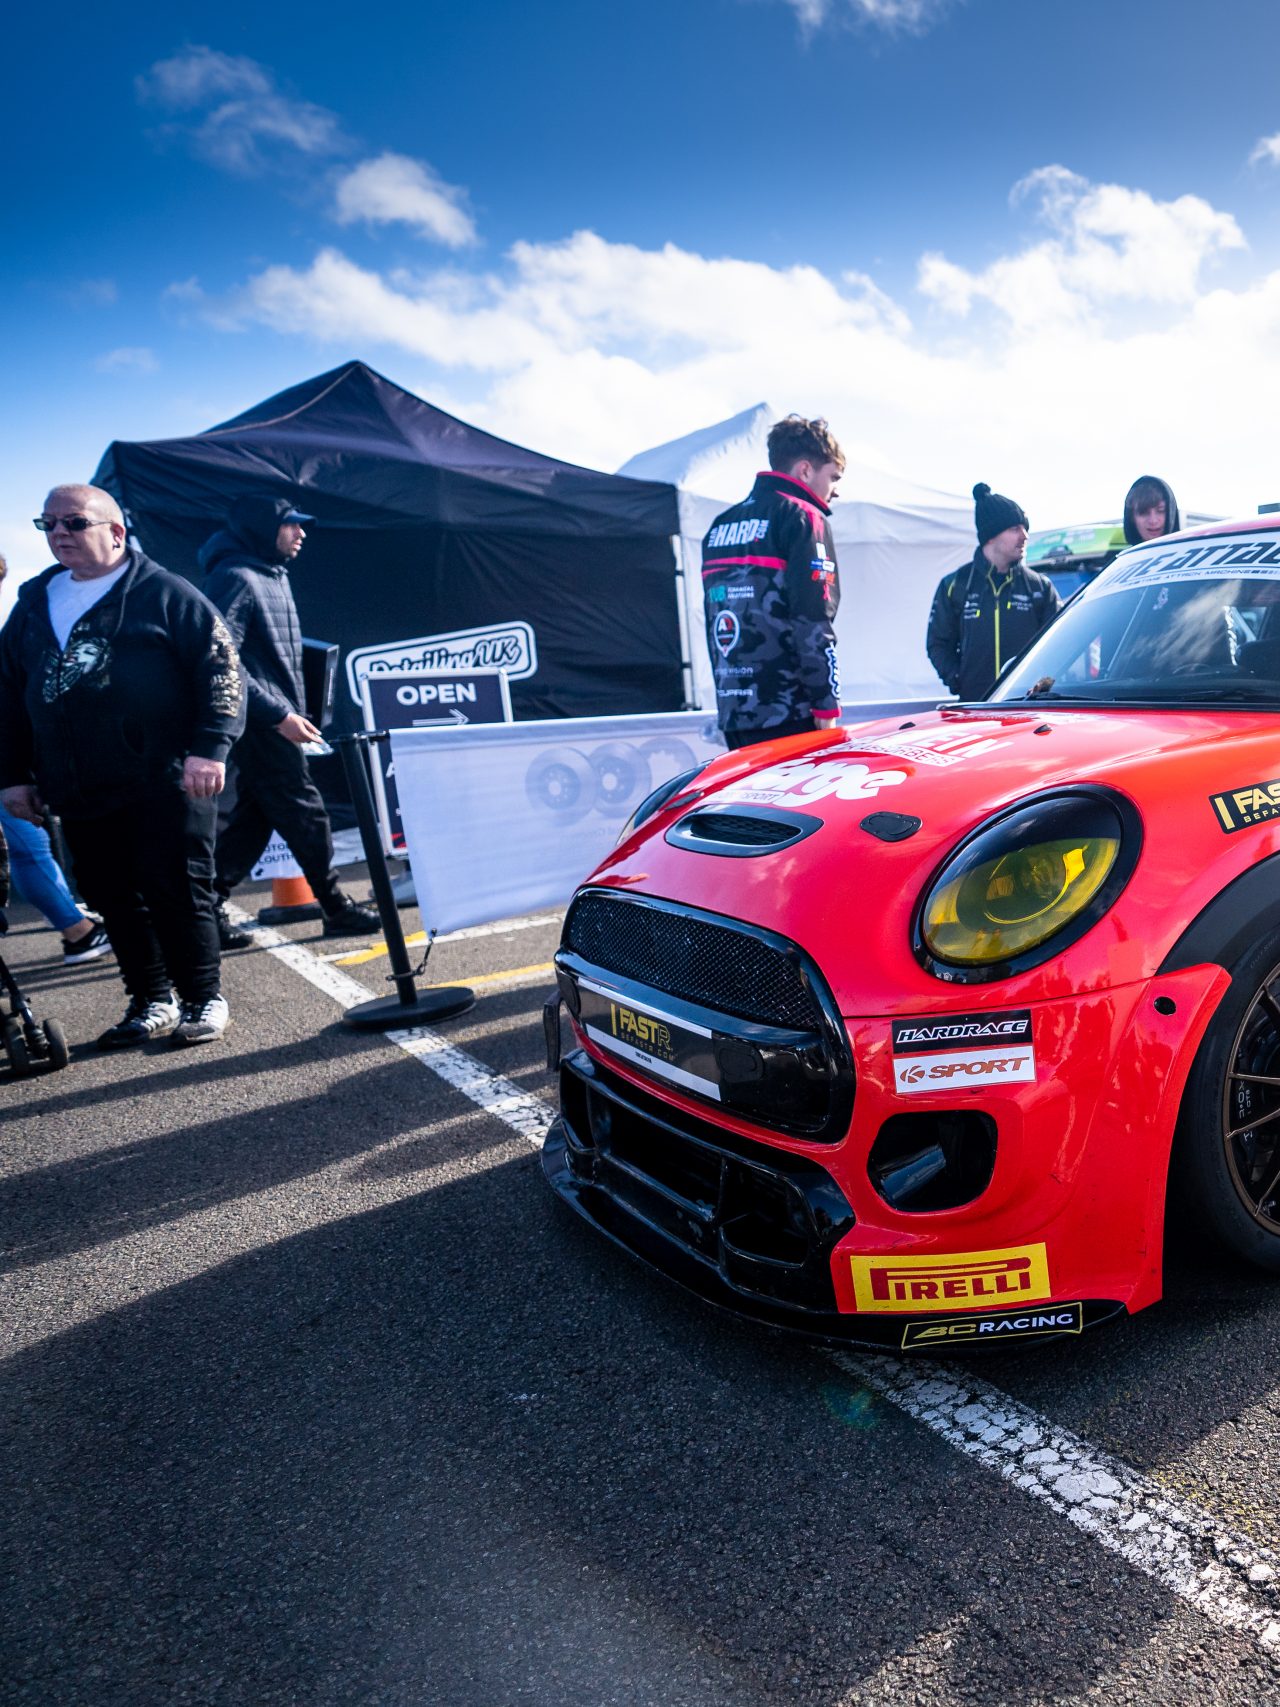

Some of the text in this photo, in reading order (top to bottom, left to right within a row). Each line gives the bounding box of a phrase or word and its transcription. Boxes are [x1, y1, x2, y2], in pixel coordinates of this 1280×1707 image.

[713, 519, 760, 547] HARD
[396, 683, 477, 705] OPEN
[620, 1007, 672, 1052] FASTR
[896, 1020, 1030, 1044] HARDRACE
[870, 1256, 1032, 1301] PIRELLI
[979, 1312, 1074, 1334] RACING
